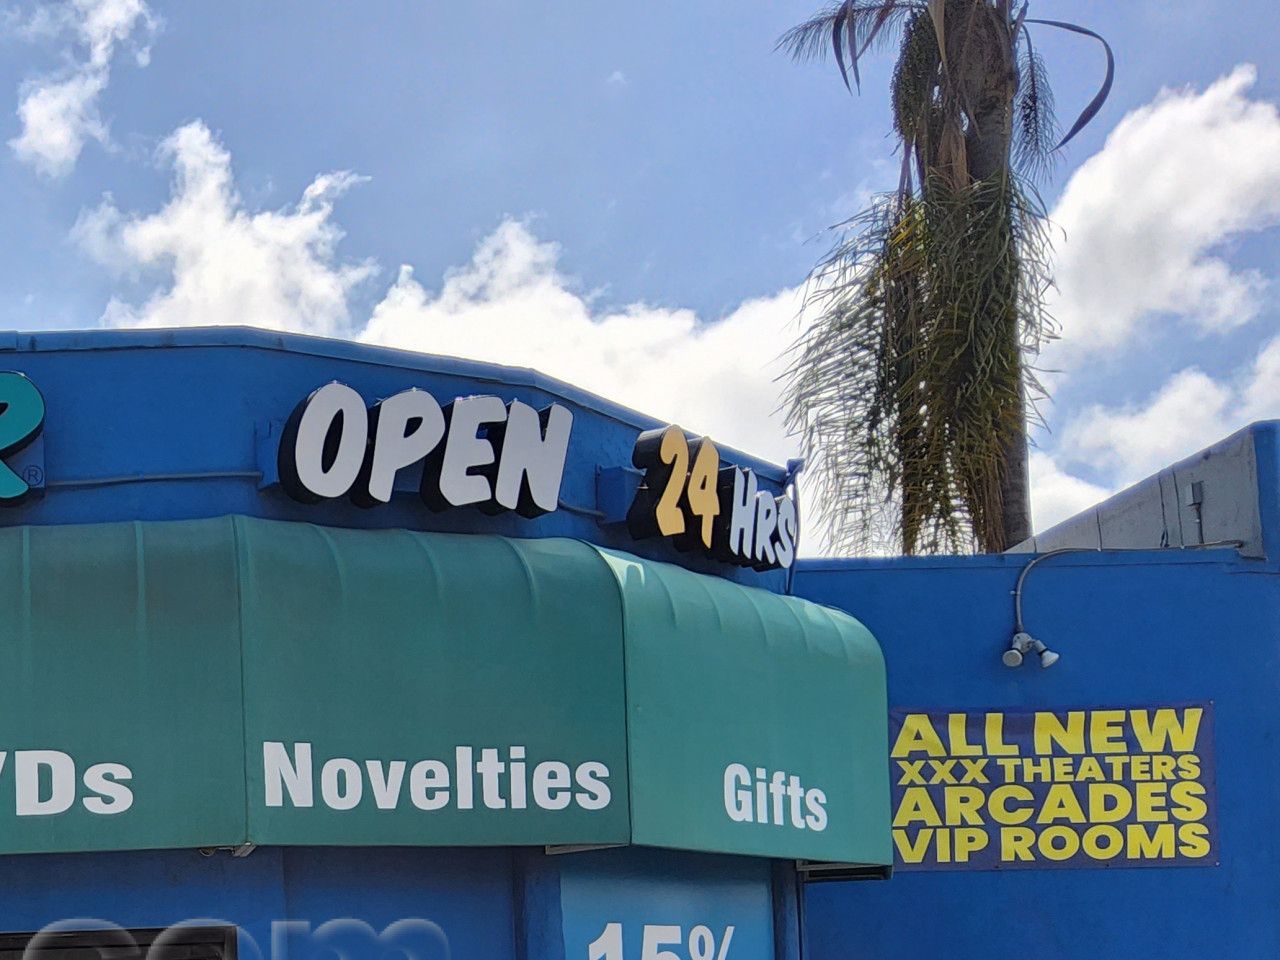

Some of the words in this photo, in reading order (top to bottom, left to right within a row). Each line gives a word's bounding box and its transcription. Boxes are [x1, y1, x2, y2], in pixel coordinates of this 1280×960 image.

[295, 382, 574, 513] OPEN
[656, 424, 720, 550] 24
[730, 465, 795, 568] HRS
[890, 713, 1020, 758] ALL
[1034, 708, 1203, 755] NEW
[263, 741, 611, 810] Novelties
[722, 762, 828, 832] Gifts
[897, 758, 990, 786] XXX
[997, 754, 1201, 783] THEATERS
[892, 781, 1207, 827] ARCADES
[892, 828, 989, 864] VIP
[1001, 823, 1211, 862] ROOMS
